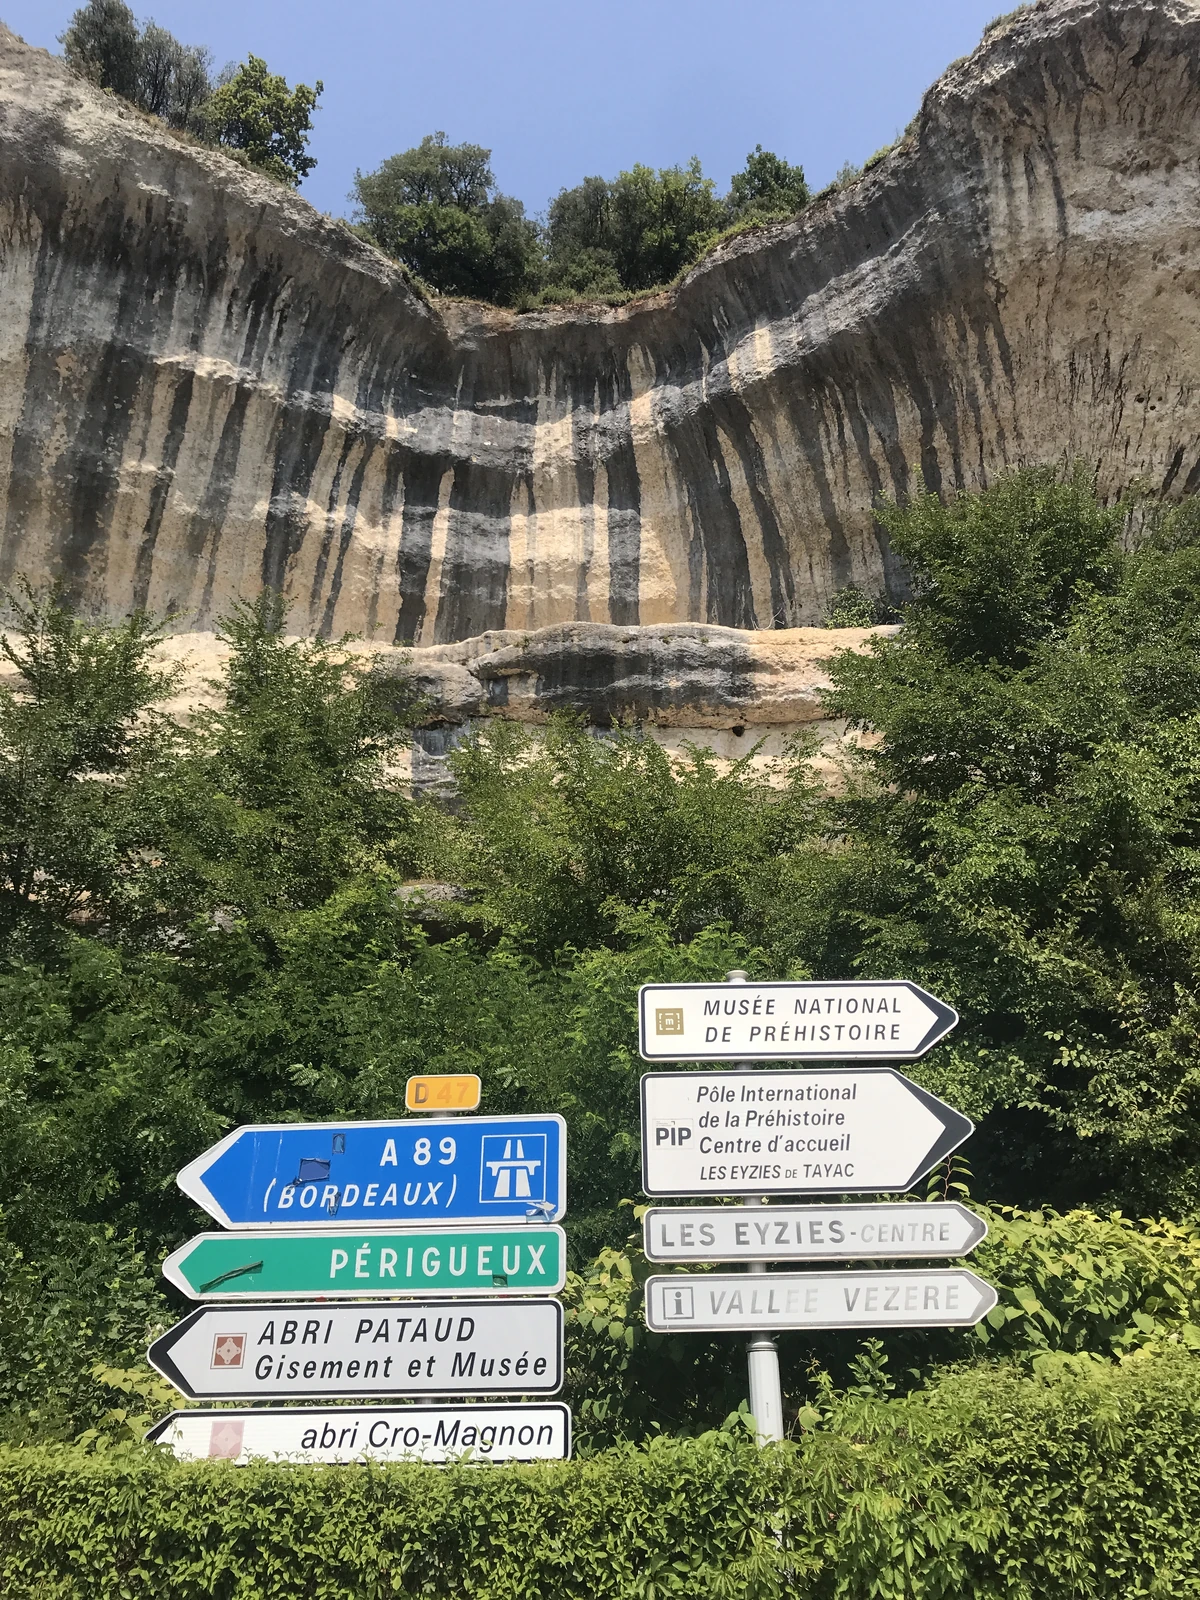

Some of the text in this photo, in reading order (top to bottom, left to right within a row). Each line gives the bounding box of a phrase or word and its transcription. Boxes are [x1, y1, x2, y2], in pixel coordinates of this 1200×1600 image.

[703, 995, 901, 1016] MUSÉE NATIONAL
[705, 1021, 901, 1042] DE PRÉHISTOIRE
[414, 1082, 471, 1104] D 47
[696, 1083, 857, 1103] Pôle International
[698, 1109, 845, 1128] de la Préhistoire
[655, 1127, 692, 1146] PIP
[699, 1136, 762, 1154] Centre
[380, 1137, 457, 1167] A 89
[700, 1165, 726, 1181] LES
[730, 1164, 782, 1180] EYZIES
[803, 1163, 855, 1179] TAYAC
[263, 1174, 458, 1212] (BORDEAUX)
[661, 1223, 716, 1247] LES
[330, 1243, 546, 1279] PÉRIGUEUX
[709, 1285, 960, 1315] VALLEE VEZERE
[257, 1317, 475, 1346] ABRI PATAUD
[255, 1351, 549, 1381] Gisement et Musée
[301, 1419, 554, 1452] abri Cro-Magnon
